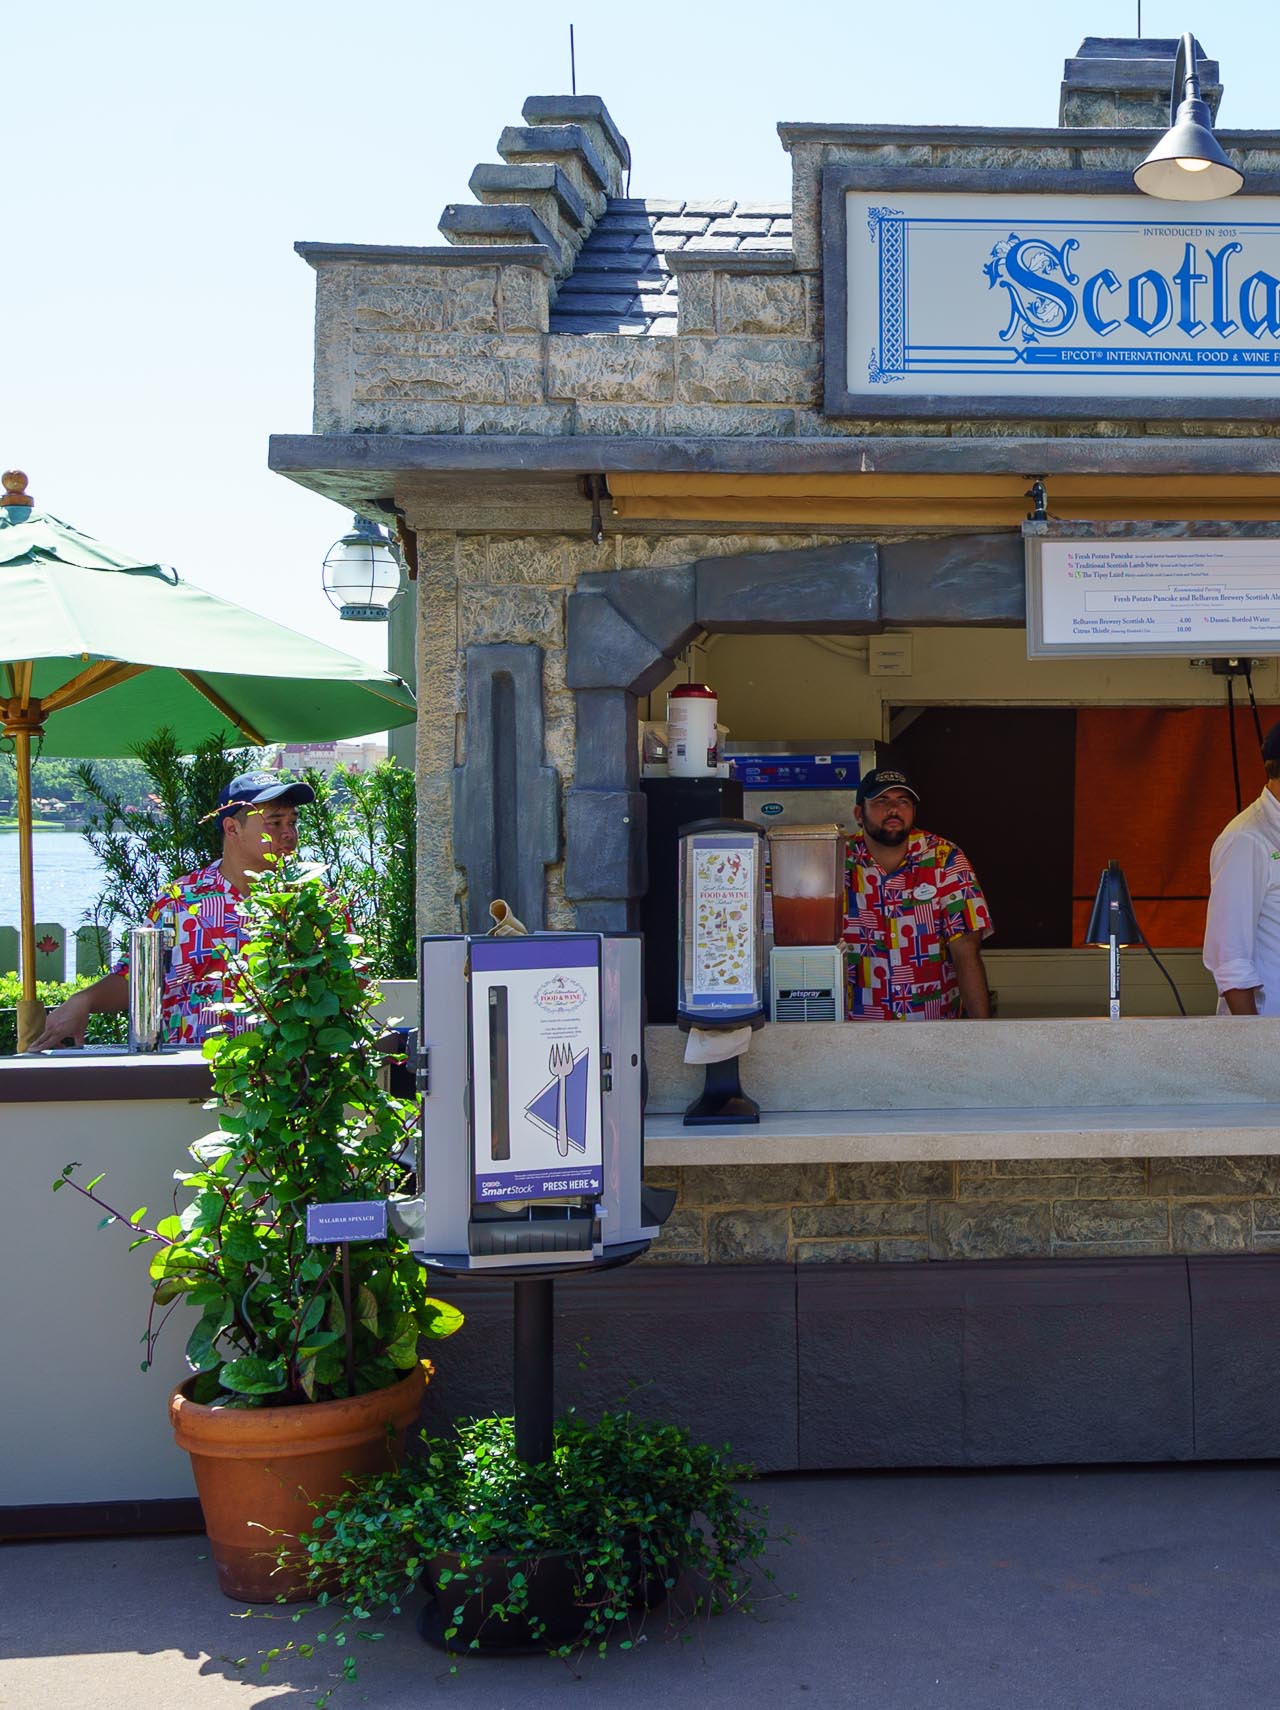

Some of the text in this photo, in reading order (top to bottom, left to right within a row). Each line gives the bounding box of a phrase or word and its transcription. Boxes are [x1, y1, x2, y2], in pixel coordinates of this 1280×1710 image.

[1143, 228, 1202, 237] INTRODUCED
[1205, 229, 1215, 237] IN
[1106, 351, 1193, 362] INTERNATIONAL
[1196, 351, 1229, 362] FOOD
[1232, 353, 1239, 362] &
[1242, 352, 1270, 363] WINE
[1152, 594, 1177, 602] Pancake
[1220, 594, 1244, 603] Brewery
[1245, 593, 1270, 601] Scottish
[1270, 592, 1280, 600] Ale
[1099, 618, 1121, 626] Brewery
[788, 989, 820, 999] jetspray
[481, 1184, 535, 1197] SmartStock
[543, 1179, 589, 1192] PRESS HERE
[319, 1215, 375, 1224] MALABAR SPINACH
